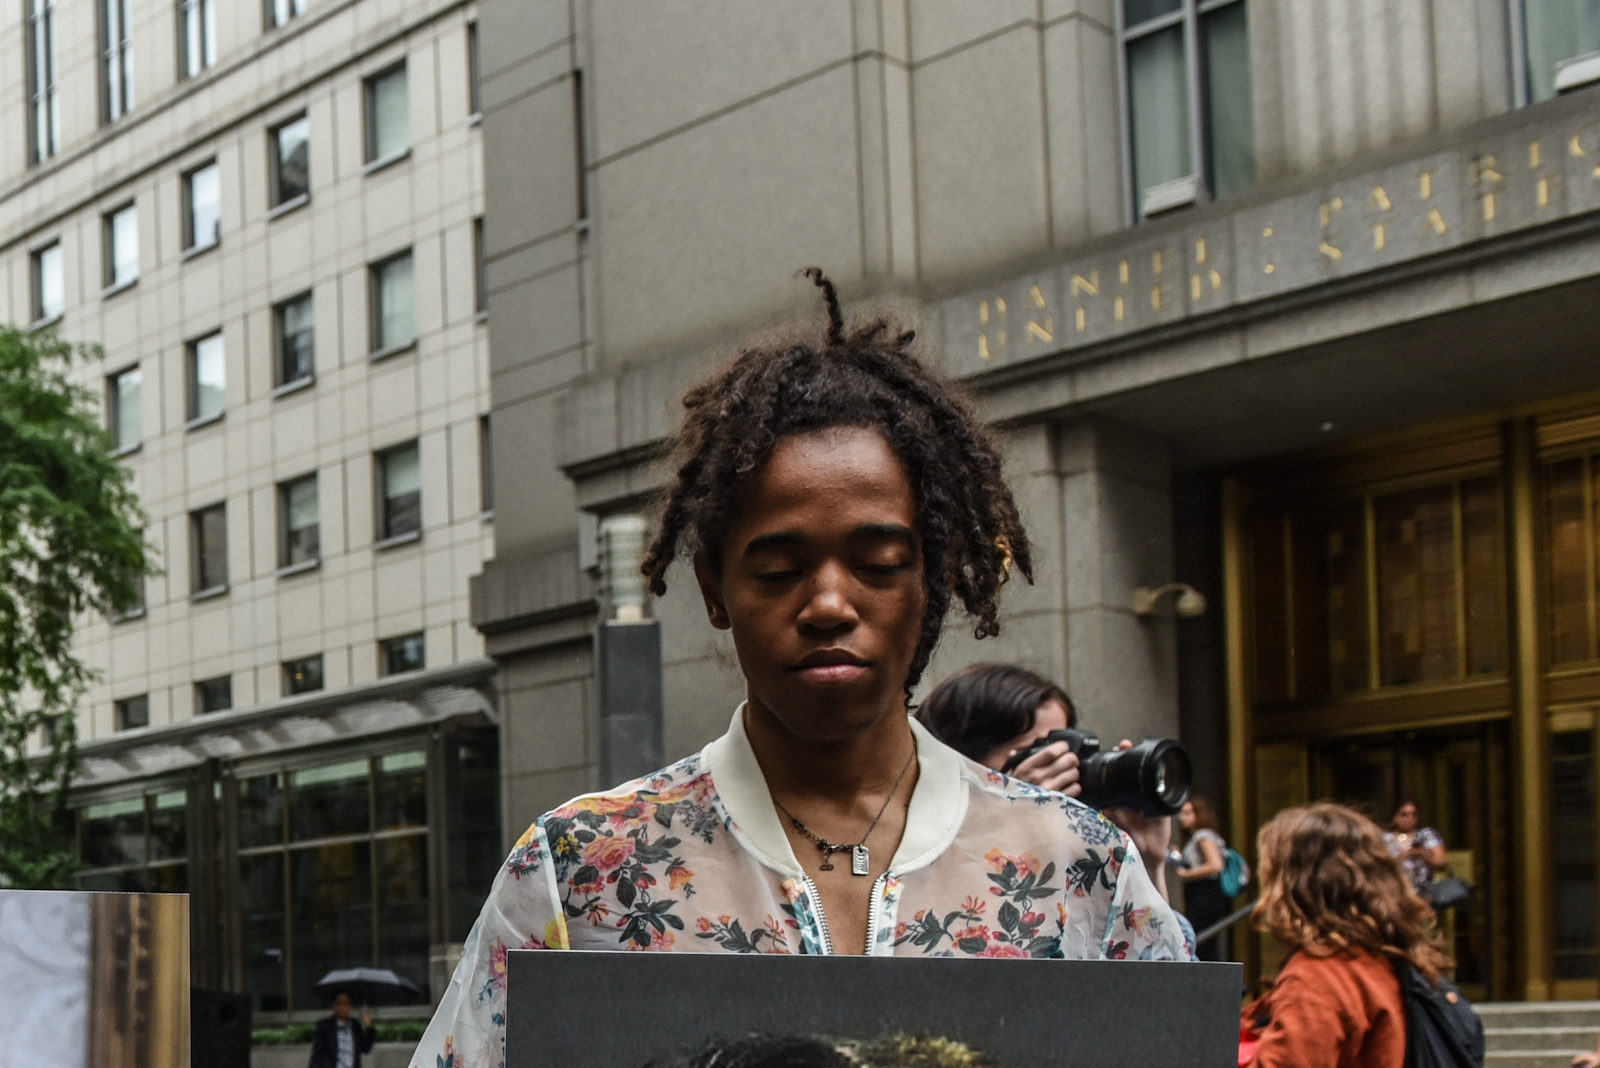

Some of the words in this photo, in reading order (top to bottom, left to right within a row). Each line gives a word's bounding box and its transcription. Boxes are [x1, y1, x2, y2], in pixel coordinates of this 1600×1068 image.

[978, 269, 1222, 359] UNITED
[1318, 162, 1600, 262] STATE
[978, 237, 1220, 326] DANIEL
